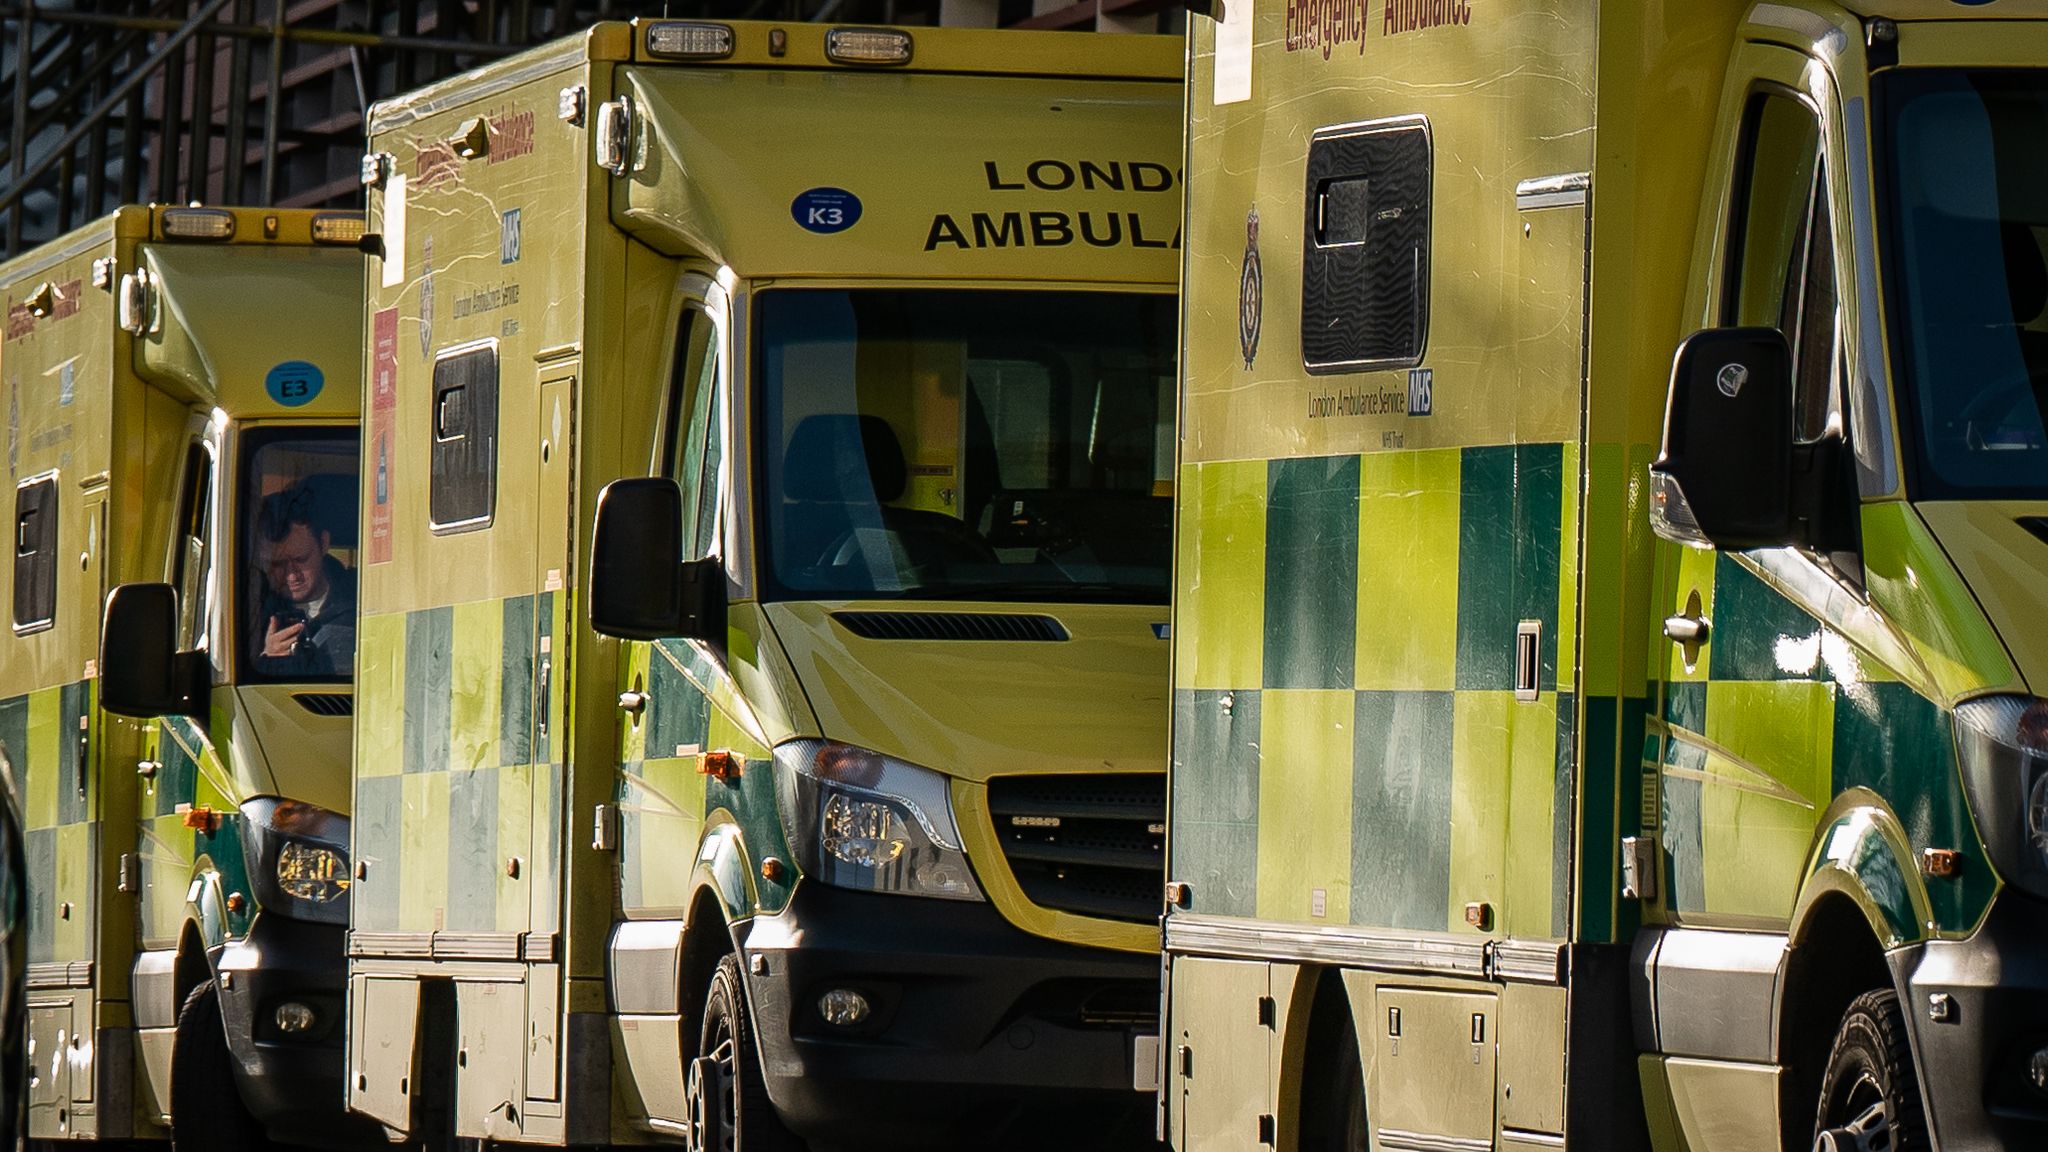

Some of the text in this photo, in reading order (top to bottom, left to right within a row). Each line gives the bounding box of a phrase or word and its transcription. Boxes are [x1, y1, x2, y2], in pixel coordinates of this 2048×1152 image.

[984, 159, 1183, 192] LOND
[808, 207, 843, 225] K3
[923, 211, 1181, 252] AMBUL
[281, 380, 308, 398] E3
[1308, 371, 1432, 418] London Ambulance Service NHS
